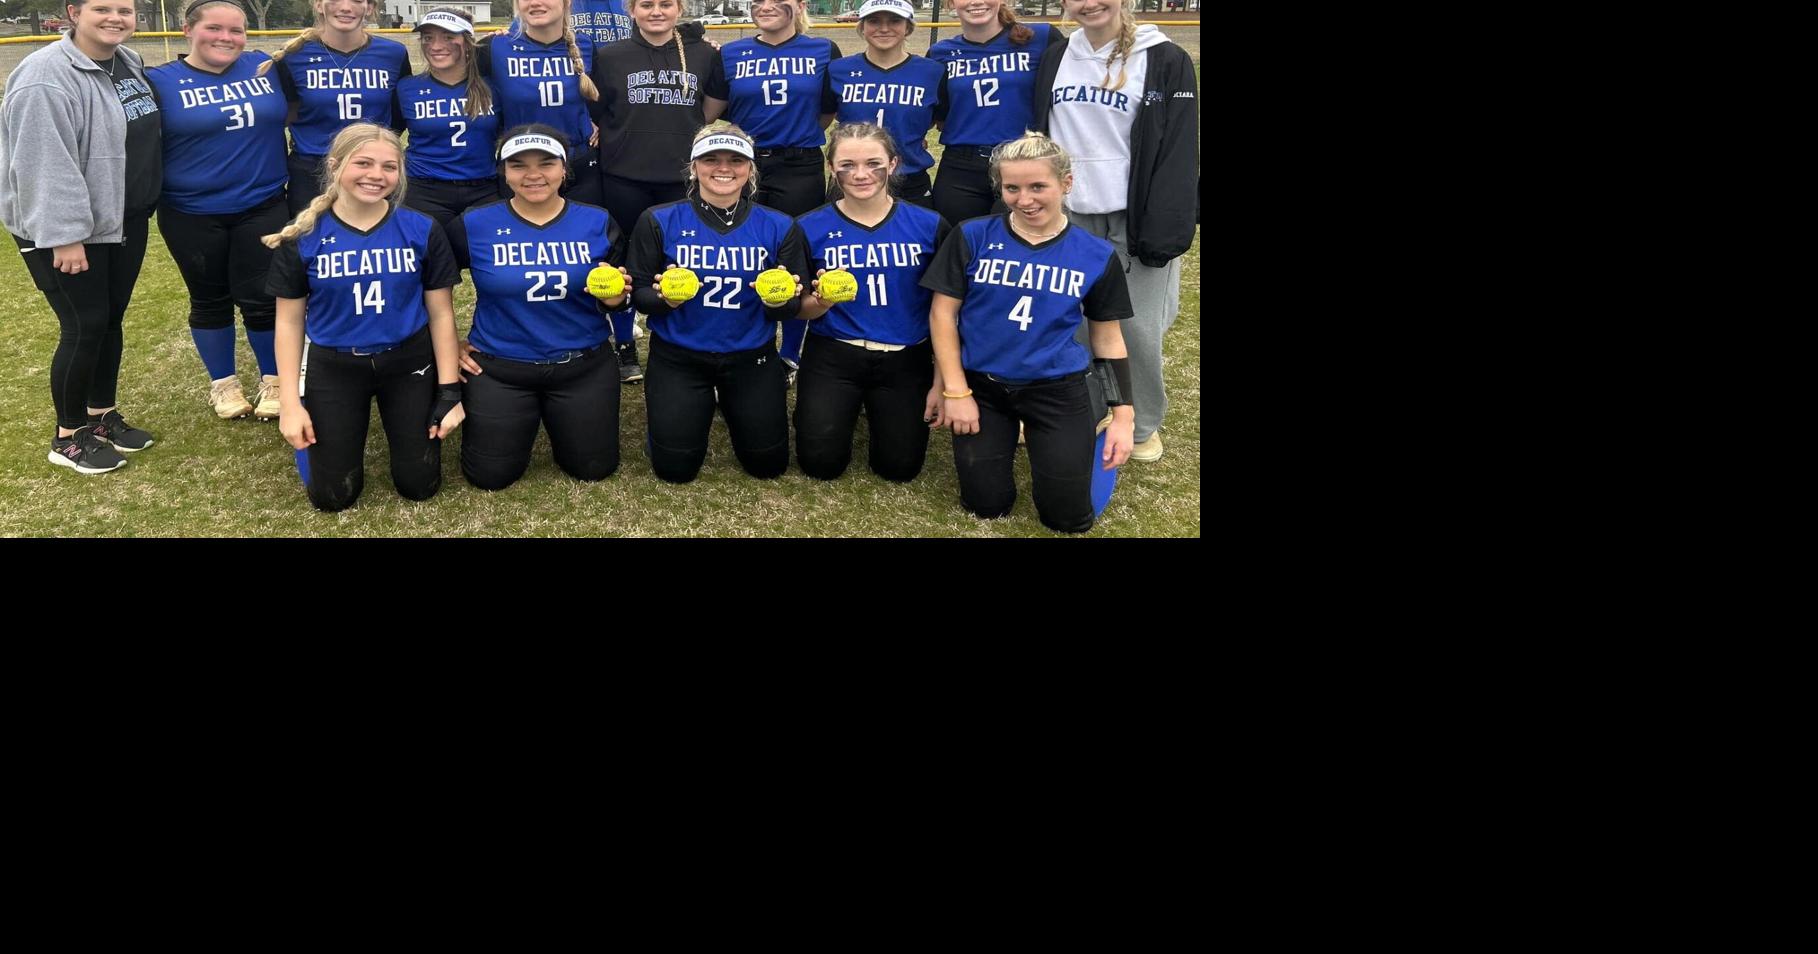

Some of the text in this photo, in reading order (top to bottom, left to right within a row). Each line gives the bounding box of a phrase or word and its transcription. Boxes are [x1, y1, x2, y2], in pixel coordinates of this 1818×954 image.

[426, 14, 457, 22] DECATUR
[306, 68, 389, 89] DECATUR
[507, 57, 583, 77] DECATU
[735, 57, 816, 79] DECATUR
[947, 52, 1030, 79] DECATUR
[179, 76, 275, 109] DECATUR
[538, 80, 564, 107] 10
[627, 69, 698, 91] DECATUR
[761, 79, 788, 106] 13
[972, 78, 1000, 107] 12
[337, 93, 361, 120] 16
[627, 87, 696, 106] SOFTBALL
[842, 83, 925, 107] DECATUR
[1050, 85, 1128, 112] ECATUR
[220, 102, 256, 132] 31
[875, 108, 885, 128] 1
[449, 121, 467, 147] 2
[514, 137, 552, 147] DECATUR
[708, 138, 744, 148] DECATUR
[317, 248, 417, 279] DECATUR
[492, 241, 592, 266] DECATUR
[676, 245, 769, 271] DECATUR
[824, 243, 922, 270] DECATUR
[525, 271, 569, 302] 23
[866, 274, 887, 306] 11
[974, 259, 1085, 298] DECATUR
[352, 280, 386, 316] 14
[703, 276, 742, 309] 22
[1008, 296, 1033, 331] 4
